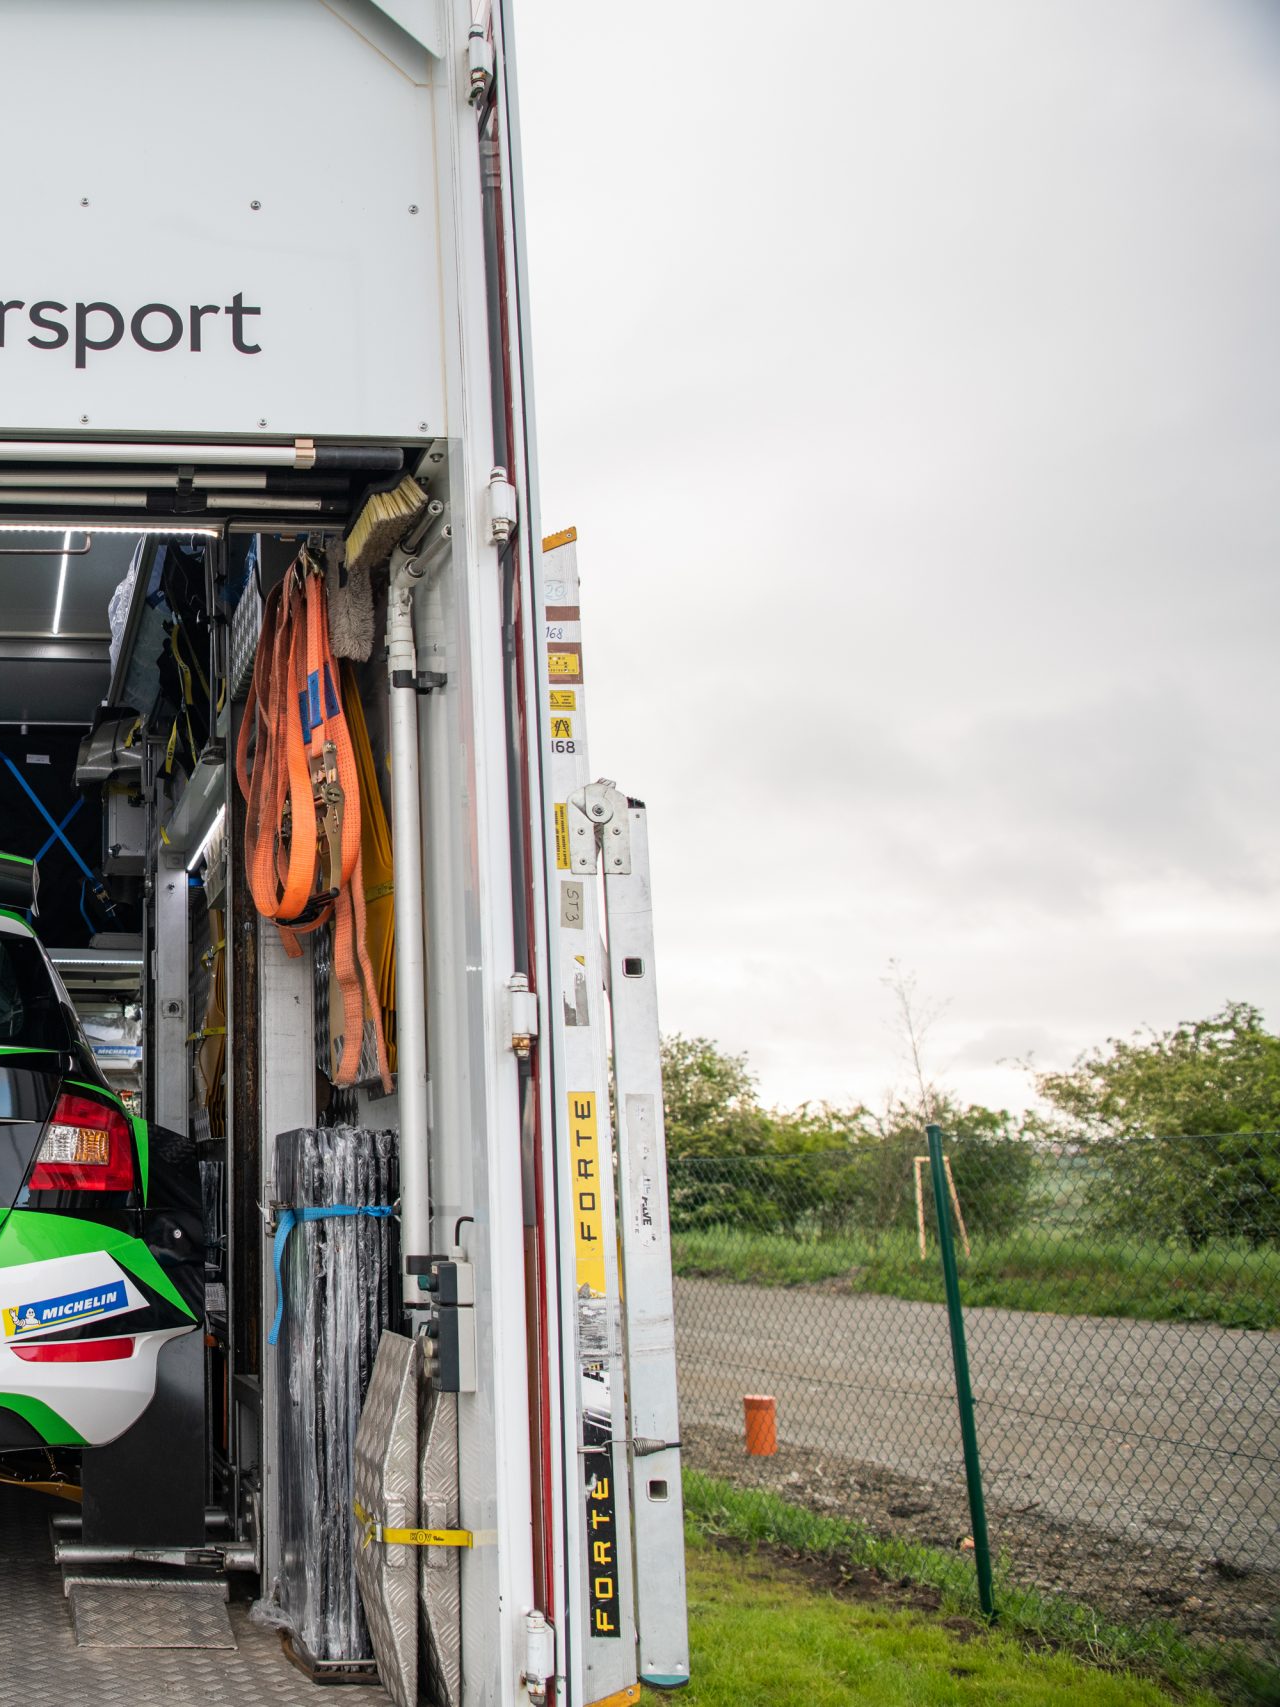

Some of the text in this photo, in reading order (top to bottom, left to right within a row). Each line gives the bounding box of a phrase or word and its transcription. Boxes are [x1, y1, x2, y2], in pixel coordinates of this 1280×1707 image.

[545, 626, 563, 639] 168
[551, 740, 576, 754] 168
[574, 1100, 598, 1242] FORTE
[42, 1291, 118, 1320] MICHELIN
[591, 1477, 615, 1632] FORTE
